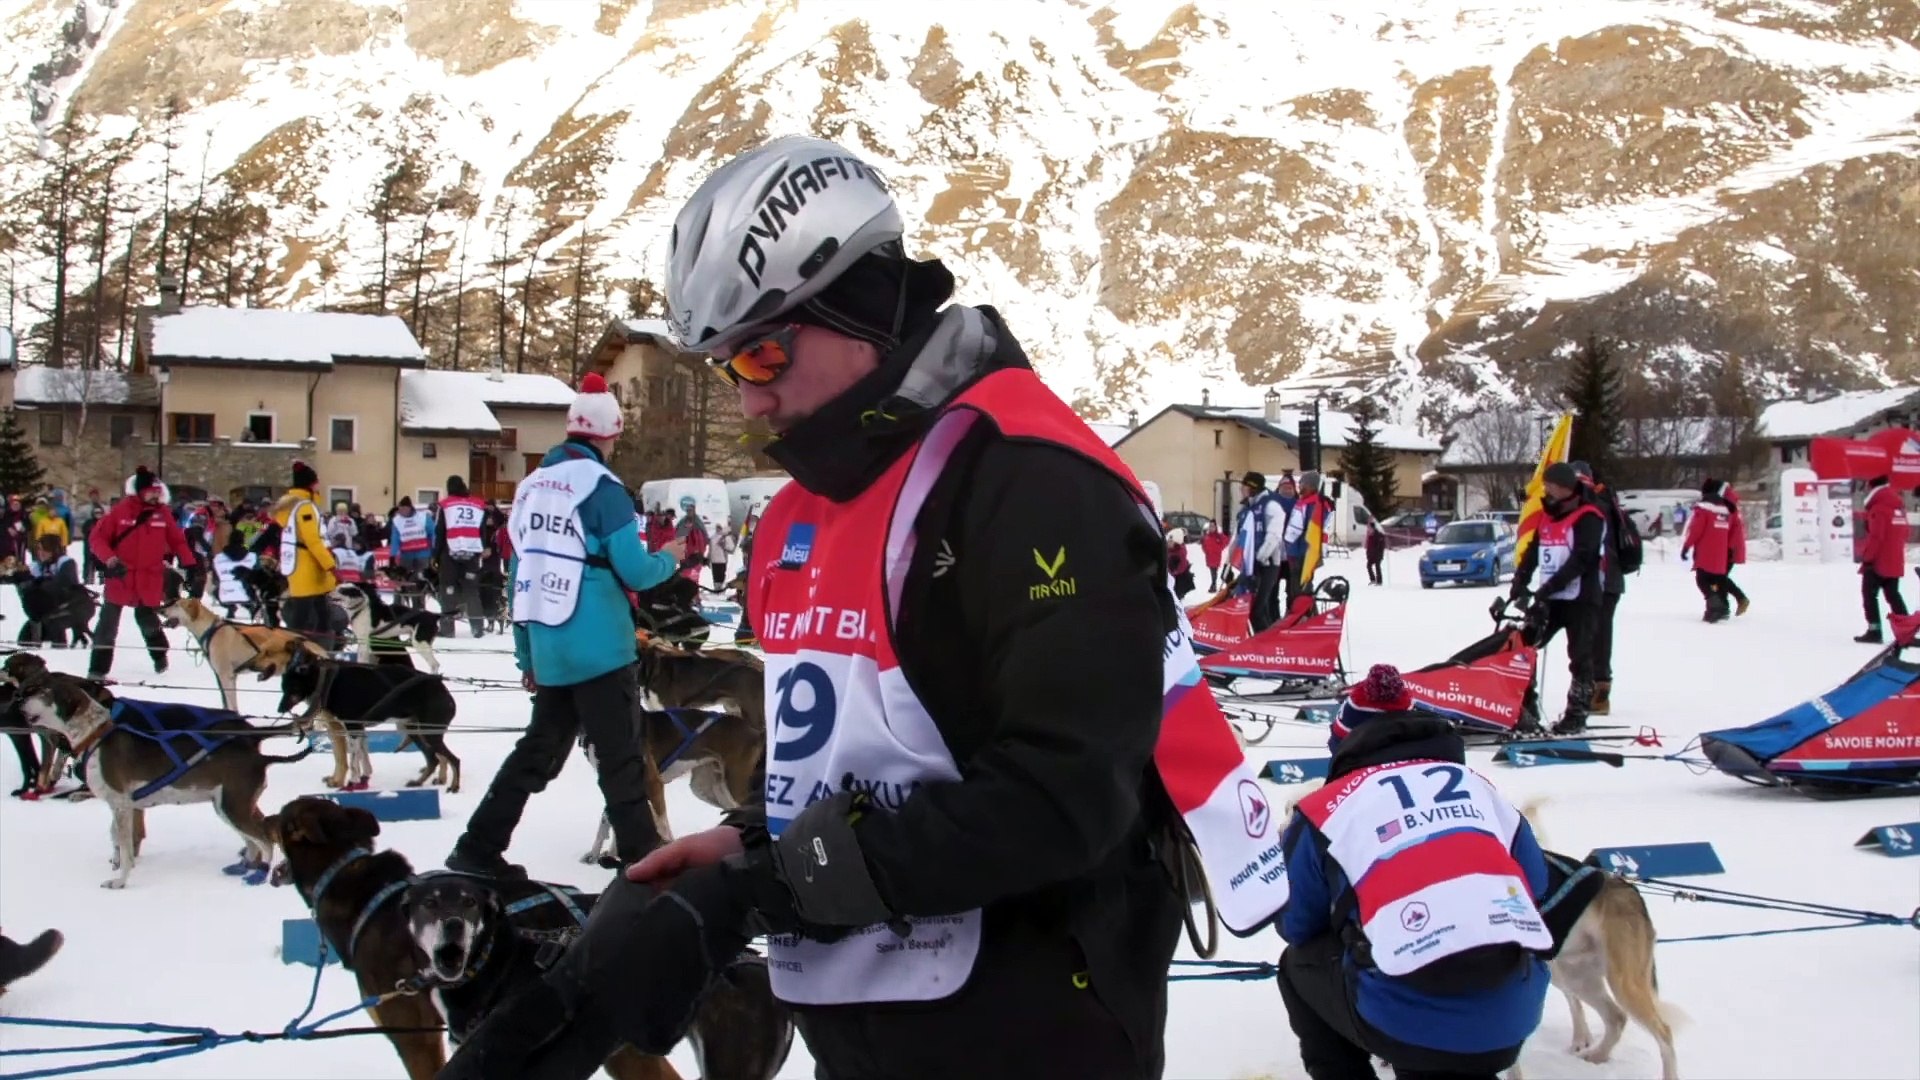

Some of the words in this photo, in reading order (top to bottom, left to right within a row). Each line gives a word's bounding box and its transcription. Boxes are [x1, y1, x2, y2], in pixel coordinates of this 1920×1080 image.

[738, 156, 866, 290] DYNAFIT
[457, 507, 474, 520] 23
[782, 544, 809, 562] bleu
[1229, 654, 1264, 664] SAVOIE
[1266, 655, 1296, 666] MONT
[1297, 656, 1331, 667] BLANC
[1437, 690, 1474, 704] MONT
[1474, 697, 1514, 718] BLANC
[1825, 736, 1873, 749] SAVOIE
[1875, 736, 1913, 748] MONT
[1377, 765, 1472, 810] 12
[1230, 861, 1259, 890] Haute
